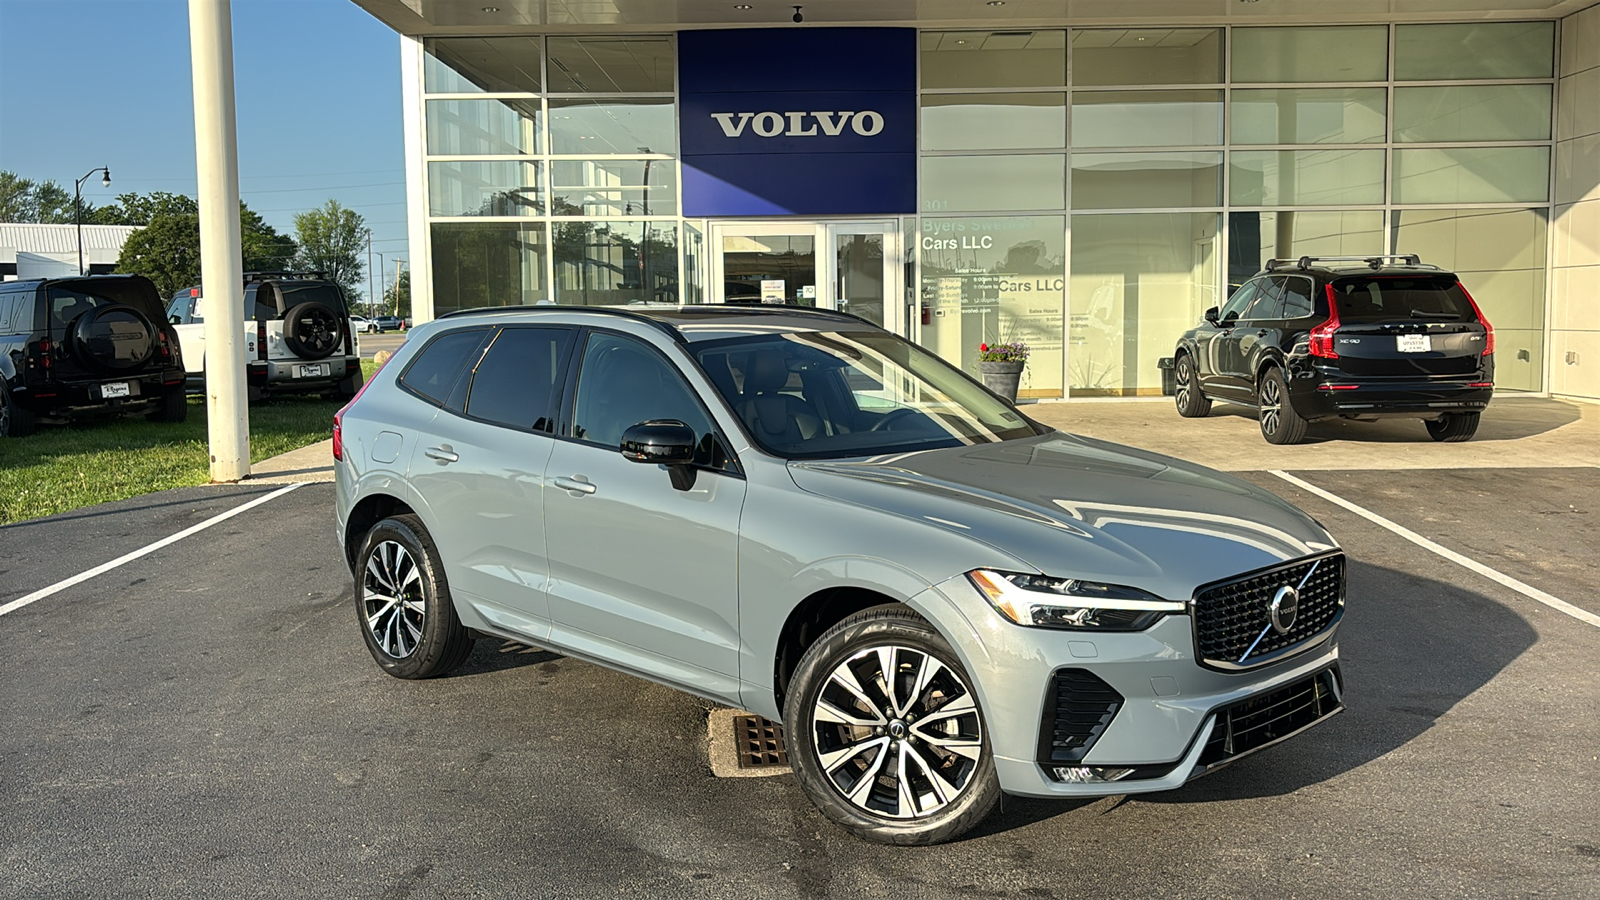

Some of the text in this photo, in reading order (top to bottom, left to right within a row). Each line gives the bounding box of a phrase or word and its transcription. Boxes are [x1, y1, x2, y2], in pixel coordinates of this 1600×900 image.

[711, 111, 884, 137] VOLVO
[923, 199, 948, 210] 301
[923, 219, 966, 236] Byers
[922, 235, 993, 250] Cars LLC
[998, 279, 1064, 292] Cars LLC
